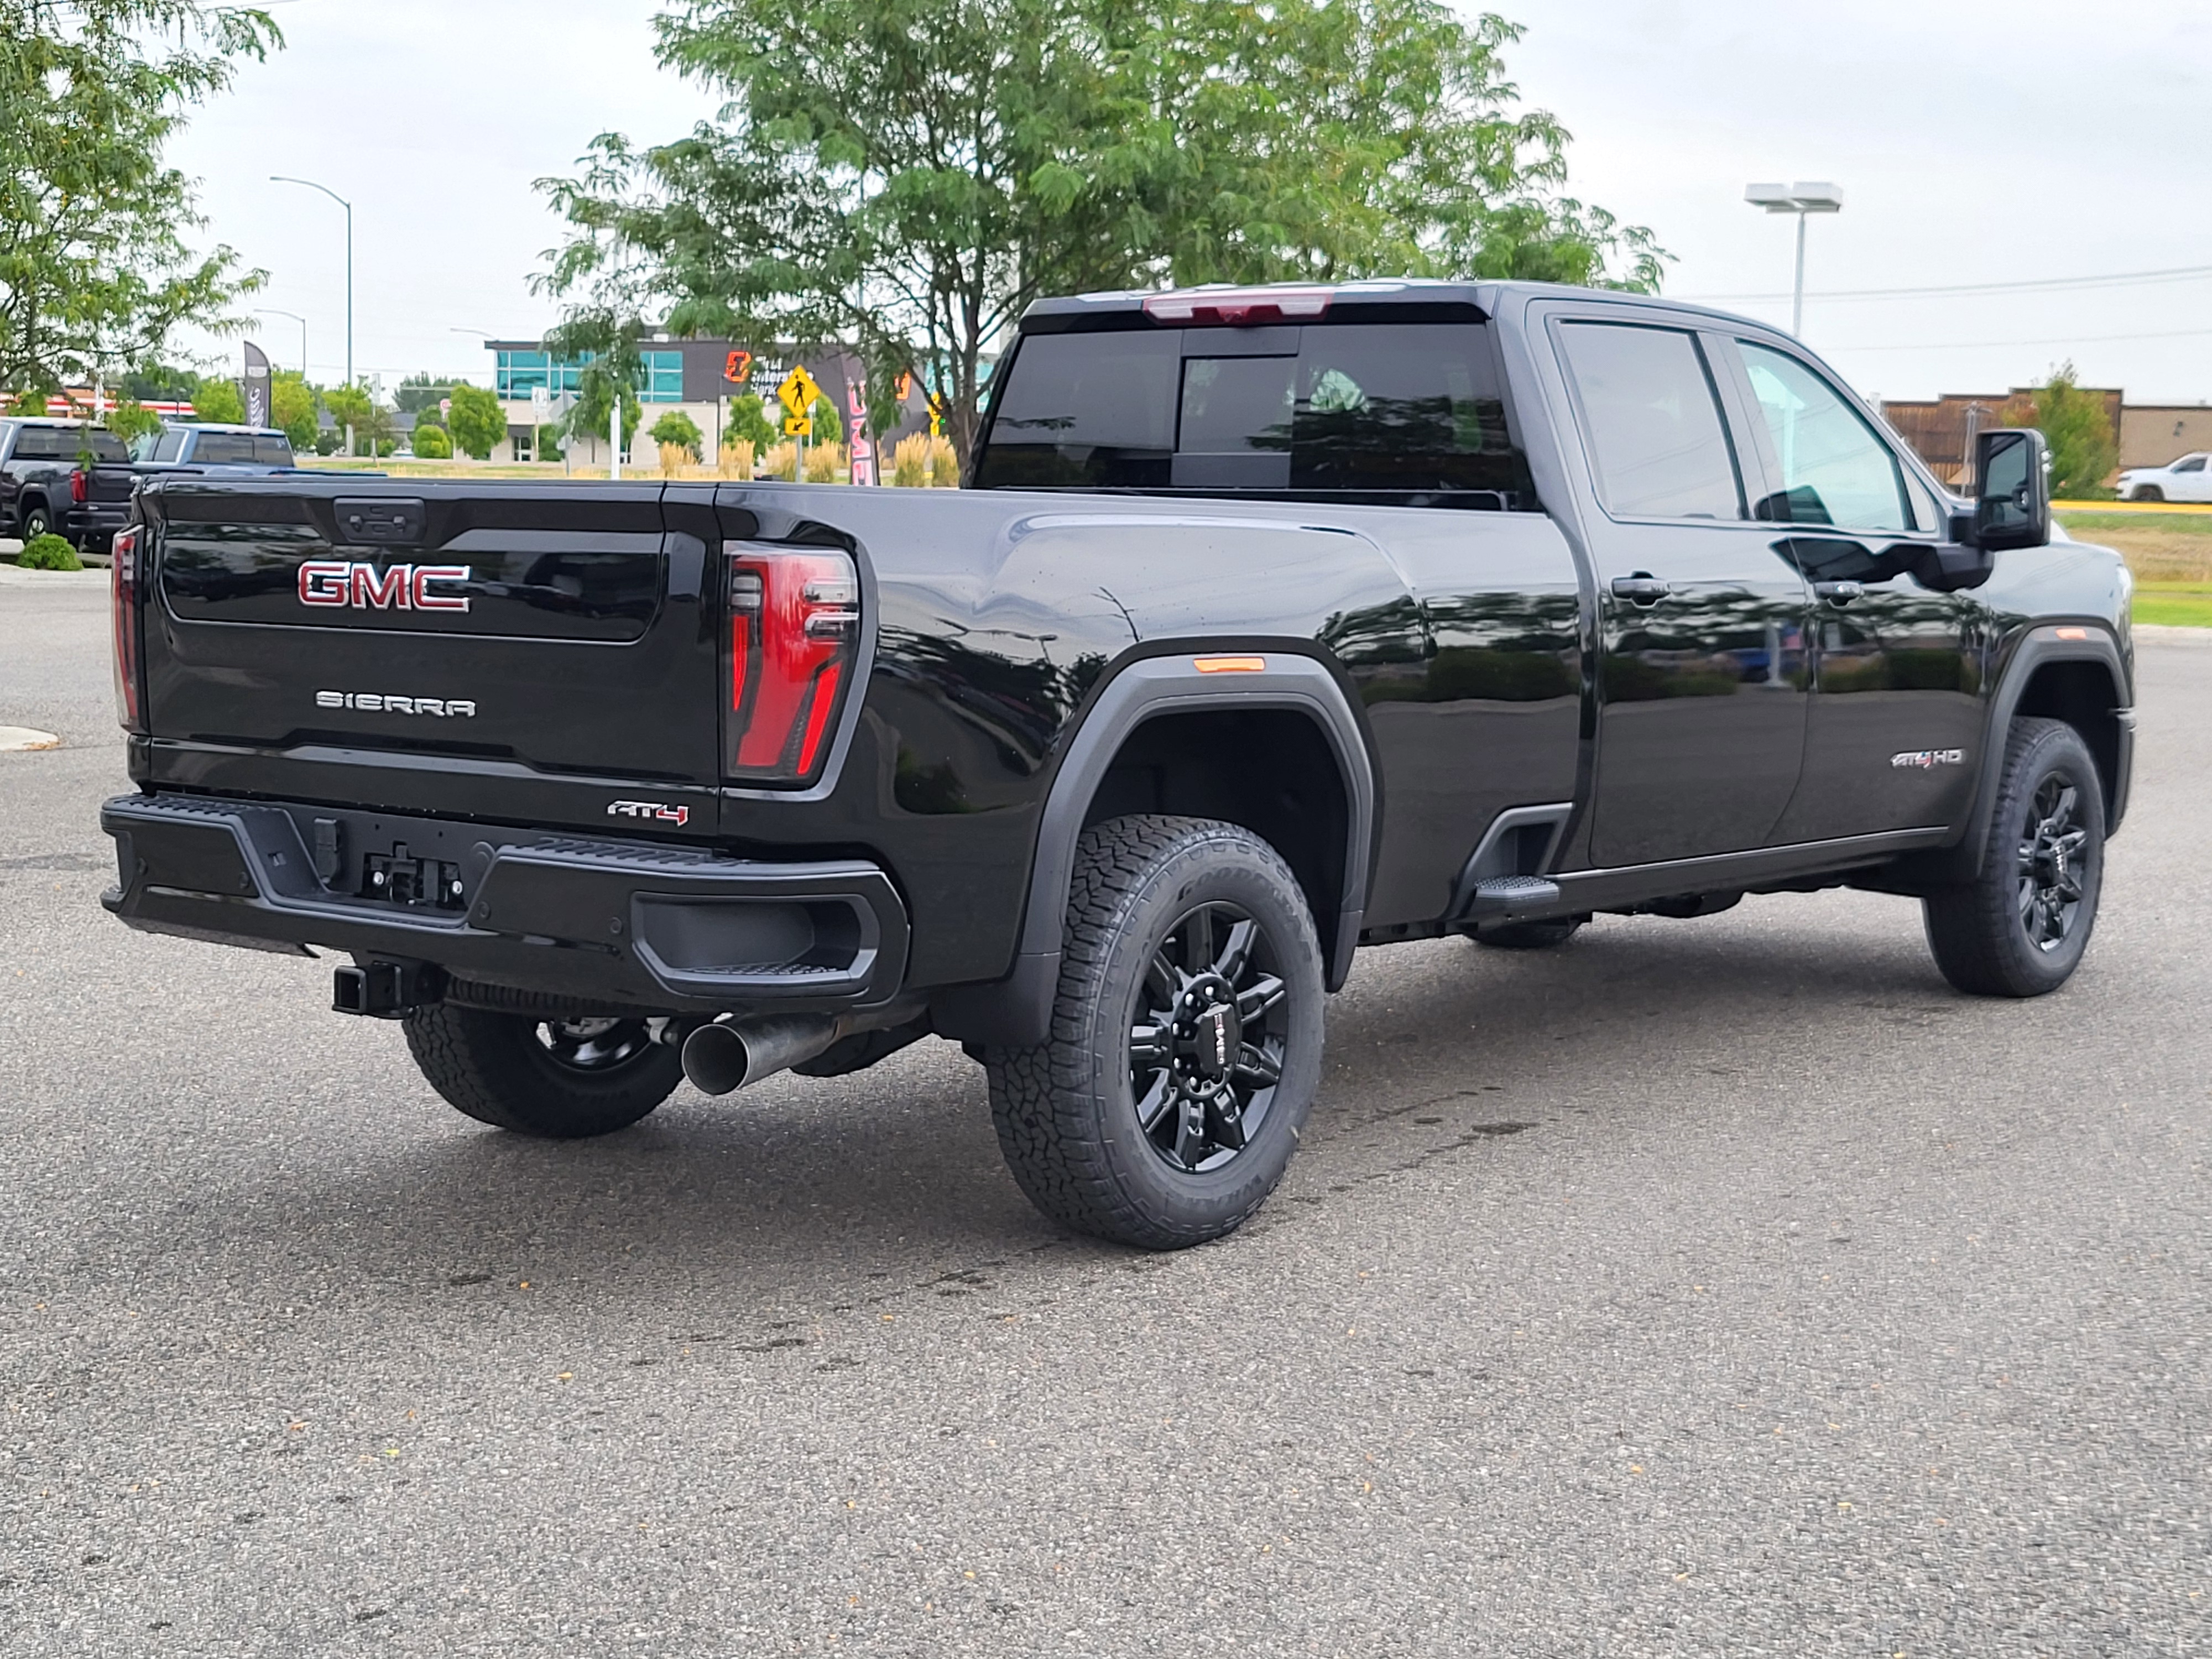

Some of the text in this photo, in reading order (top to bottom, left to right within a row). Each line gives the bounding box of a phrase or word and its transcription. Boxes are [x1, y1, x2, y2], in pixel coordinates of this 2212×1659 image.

[298, 560, 472, 613] GMC
[315, 690, 476, 717] SIERRA
[607, 800, 689, 826] AT4
[1214, 1013, 1225, 1065] GMC
